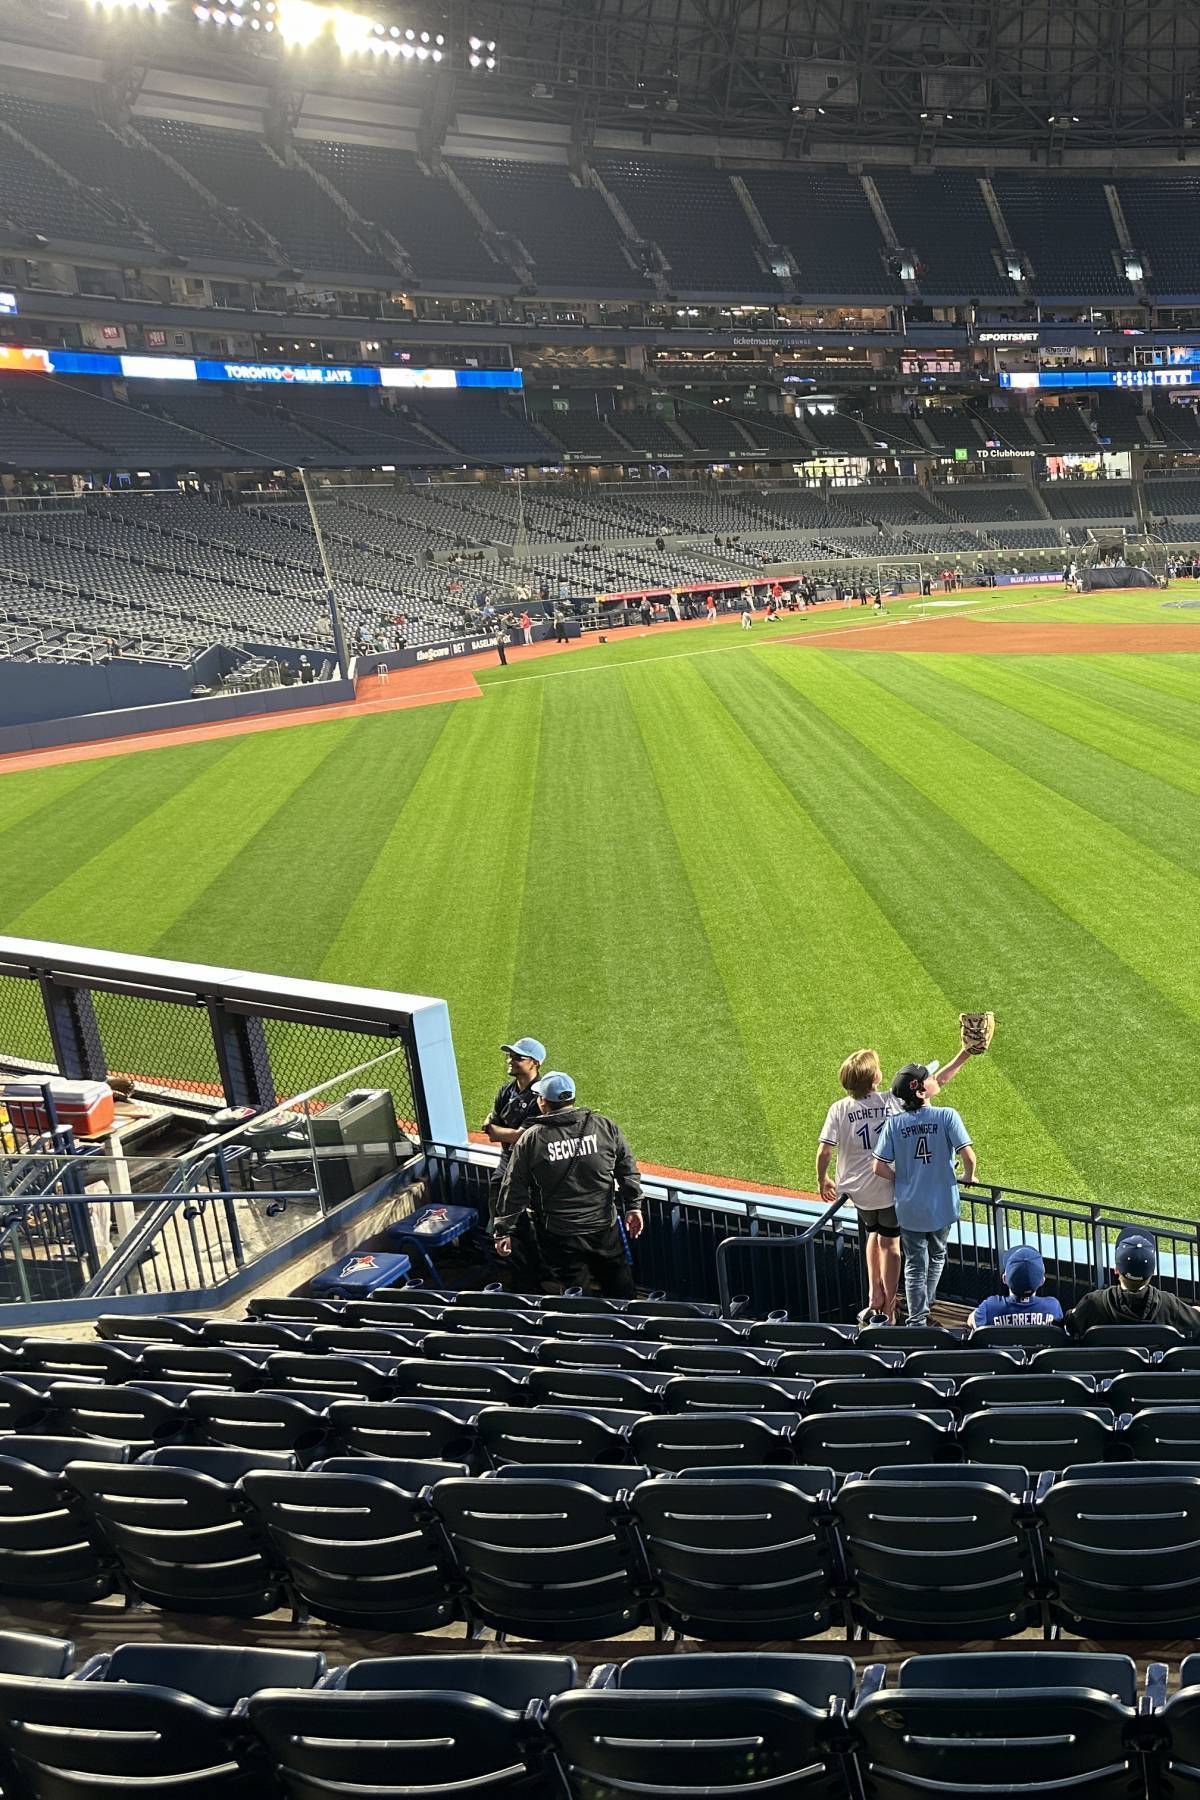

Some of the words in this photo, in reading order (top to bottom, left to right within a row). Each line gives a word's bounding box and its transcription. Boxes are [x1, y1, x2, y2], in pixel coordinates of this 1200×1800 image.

[733, 337, 779, 345] ticketmaster
[979, 333, 1039, 341] SPORTSNET
[224, 365, 281, 380] TORONTO
[294, 369, 323, 382] BLUE
[325, 370, 352, 382] JAYS
[1025, 575, 1039, 583] JAYS
[416, 646, 449, 660] theScore
[452, 642, 465, 653] BET
[848, 1106, 891, 1123] BICHETTE
[901, 1123, 938, 1139] SPRINGER
[914, 1136, 932, 1164] 4
[993, 1312, 1043, 1327] GUERRERO
